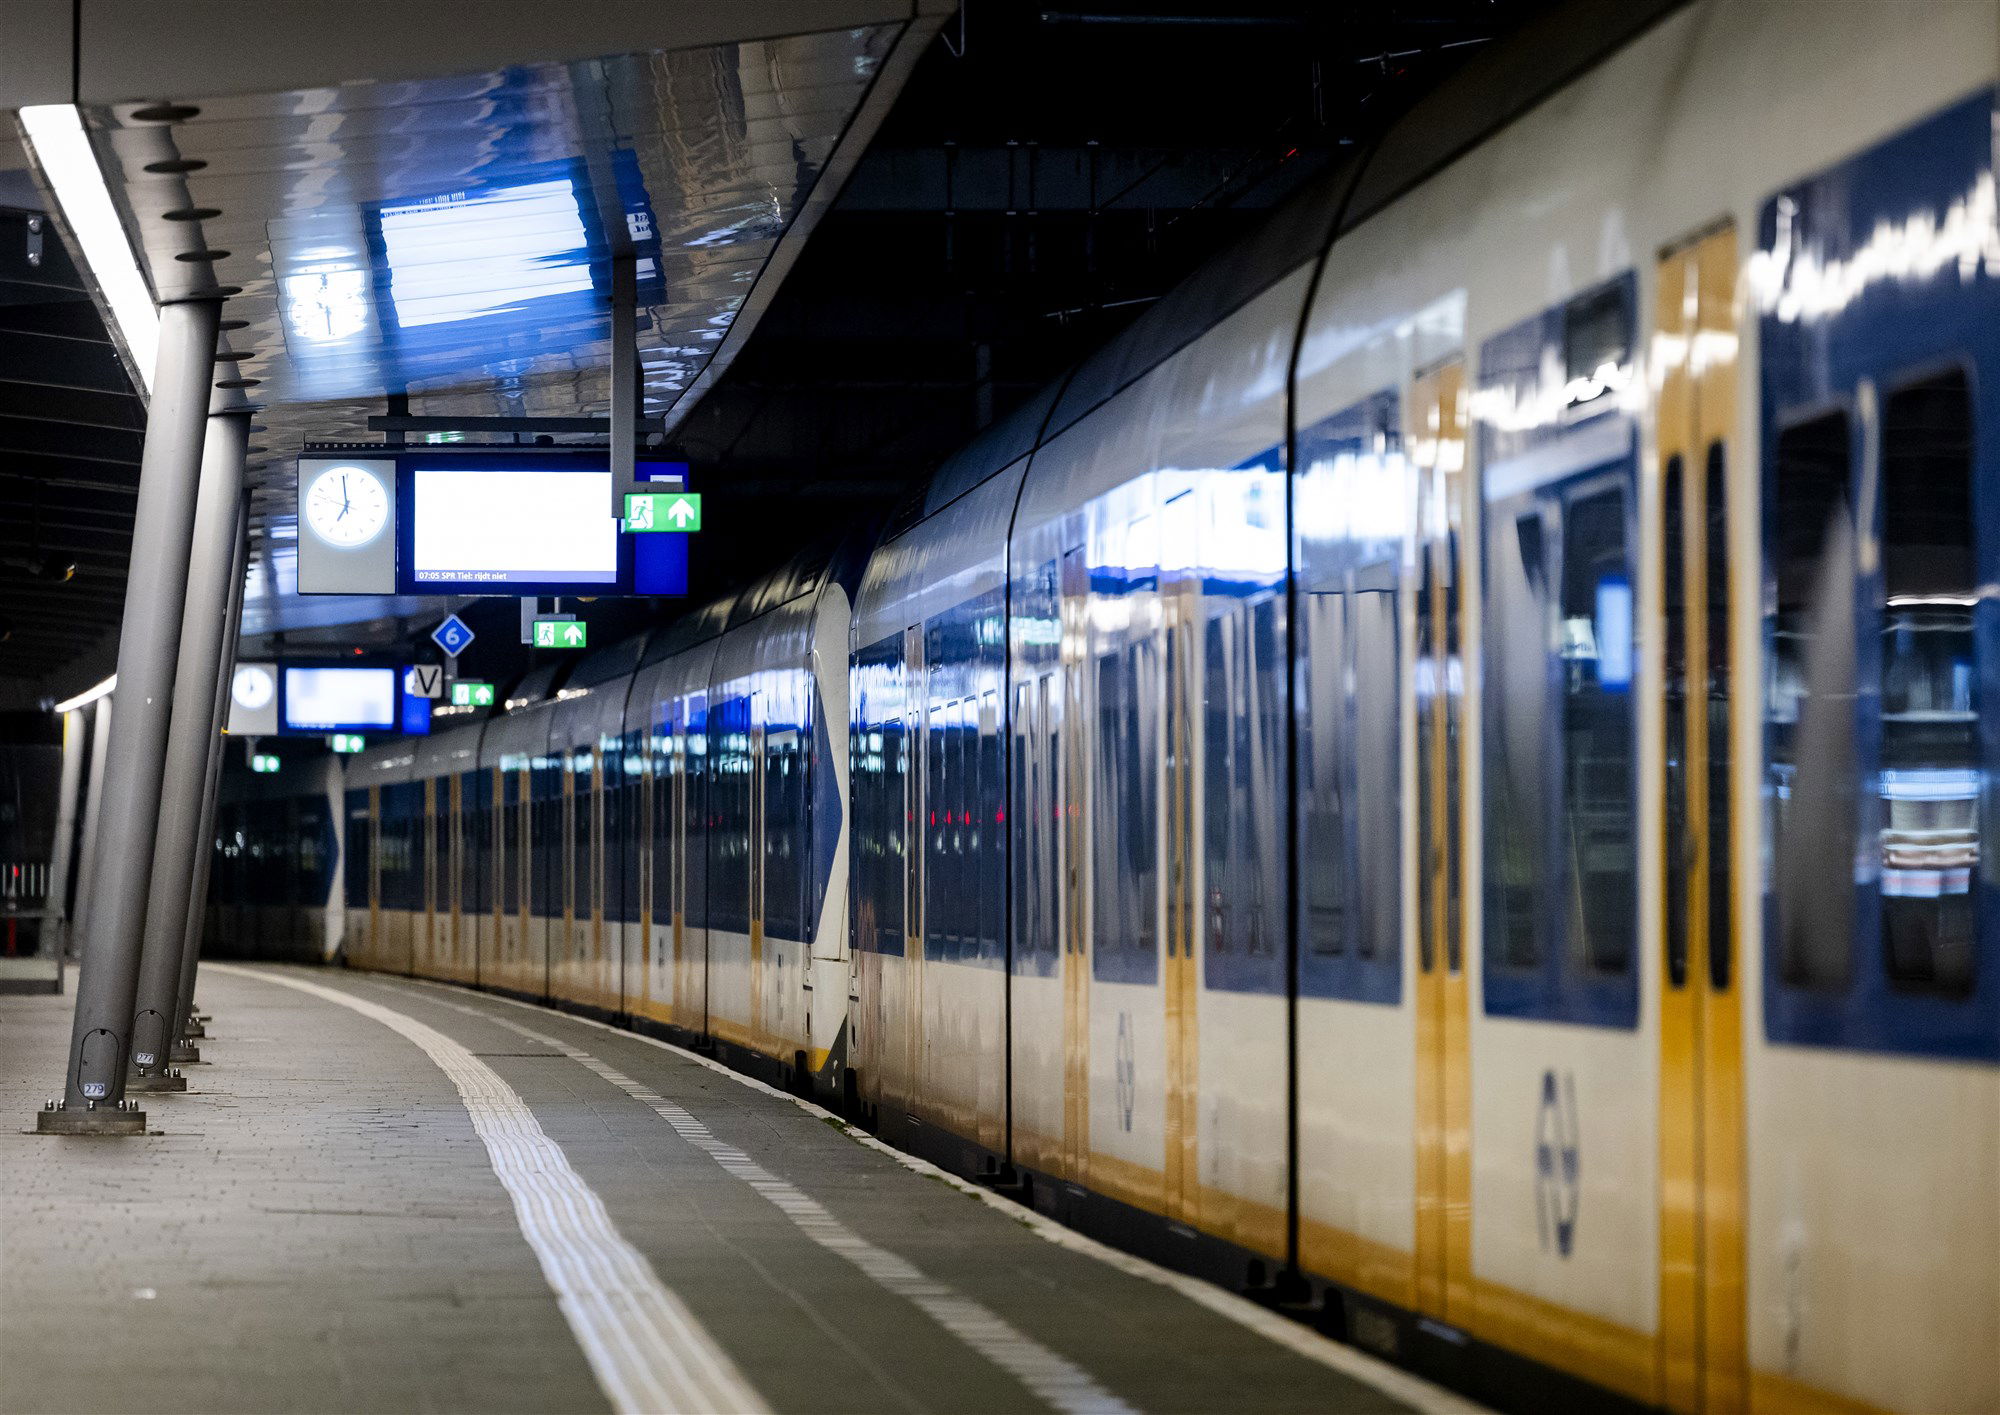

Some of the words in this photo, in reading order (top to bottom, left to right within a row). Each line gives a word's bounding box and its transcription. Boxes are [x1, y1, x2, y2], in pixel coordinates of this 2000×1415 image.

[441, 572, 456, 580] SPR
[474, 572, 490, 581] rijdt
[491, 572, 507, 580] niet
[445, 627, 460, 645] 6
[417, 668, 438, 694] V
[85, 1084, 104, 1094] 279
